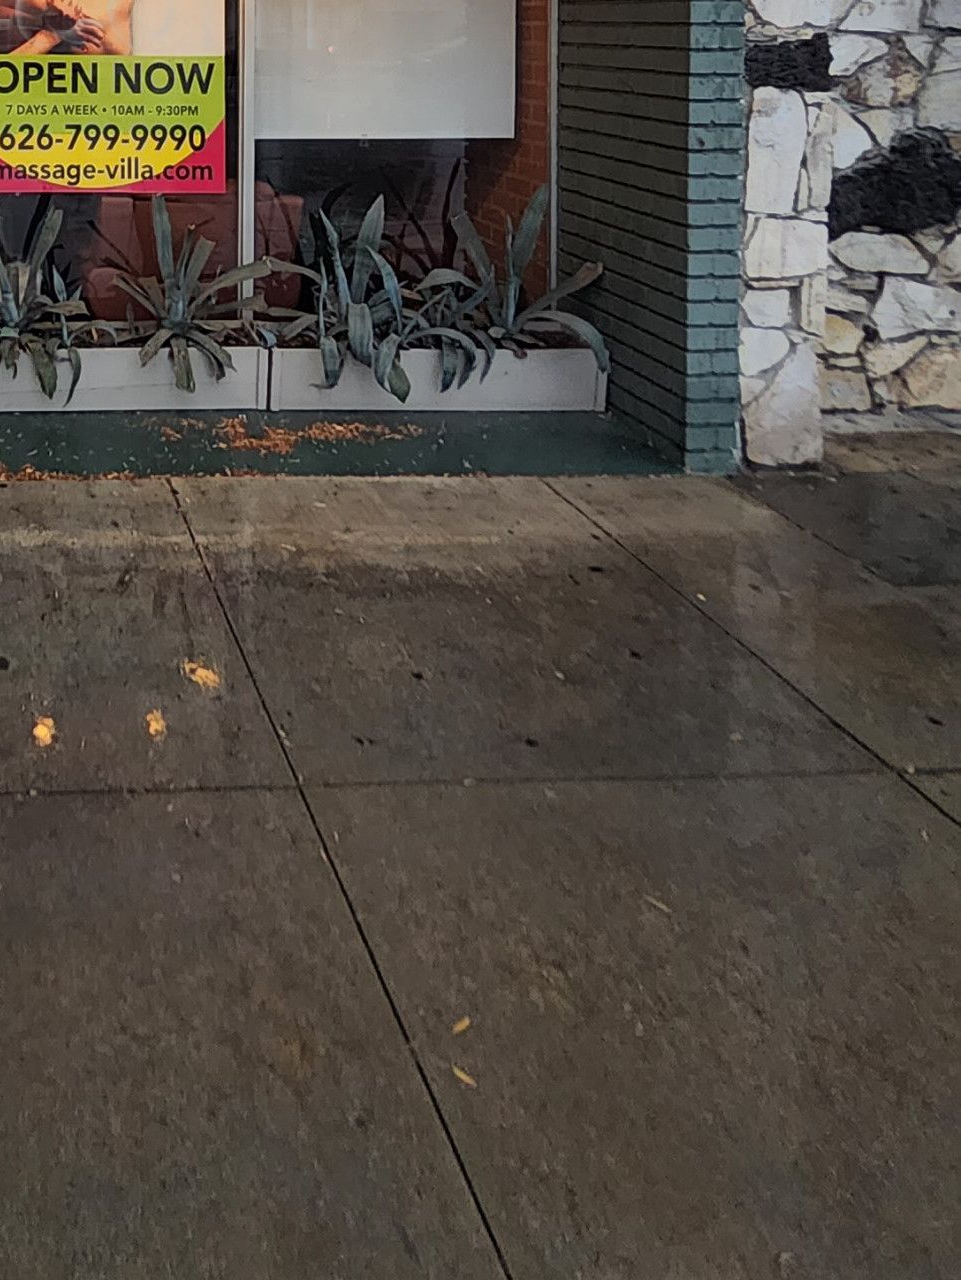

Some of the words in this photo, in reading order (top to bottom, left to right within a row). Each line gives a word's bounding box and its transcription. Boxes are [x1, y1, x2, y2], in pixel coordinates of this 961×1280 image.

[114, 62, 215, 95] NOW
[5, 104, 13, 116] 7
[17, 104, 47, 116] DAYS
[50, 104, 60, 116] A
[63, 104, 98, 117] WEEK
[111, 105, 145, 117] 10AM
[155, 105, 199, 117] 9:30PM
